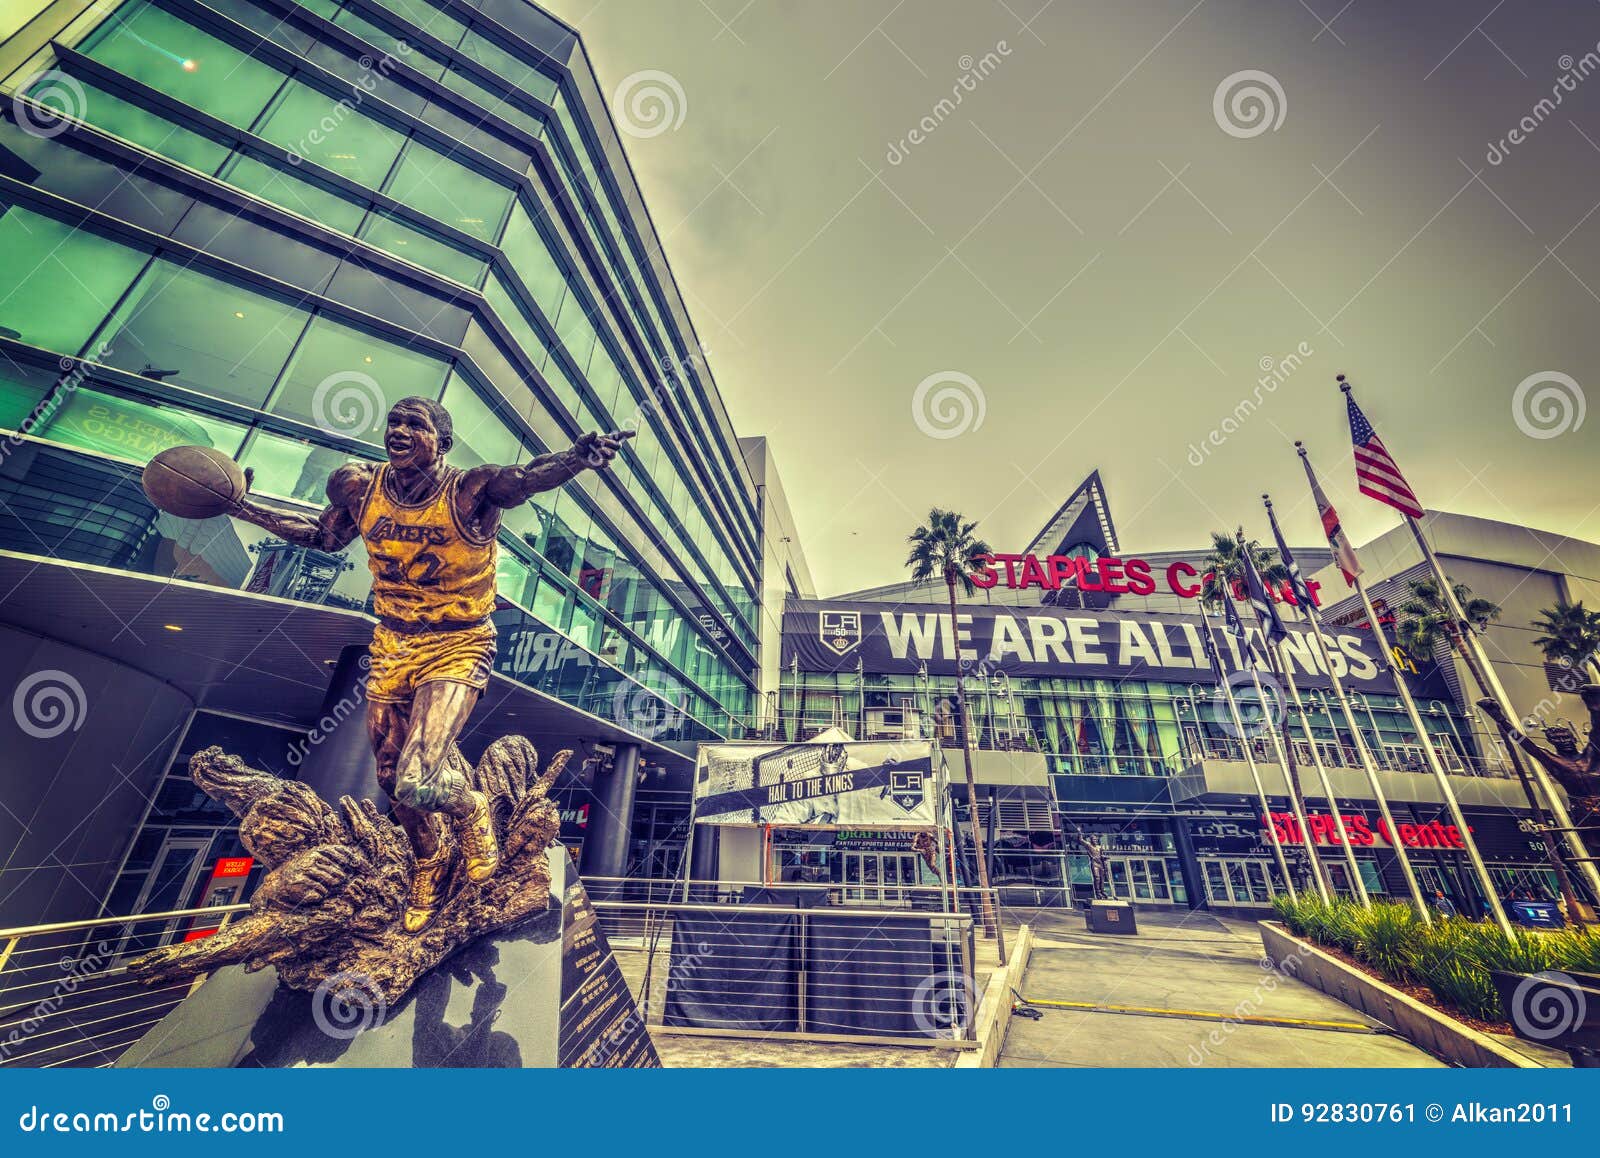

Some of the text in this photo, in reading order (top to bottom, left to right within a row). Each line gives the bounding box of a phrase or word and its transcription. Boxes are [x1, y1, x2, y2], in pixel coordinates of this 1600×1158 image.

[969, 553, 1156, 595] STAPLES
[824, 614, 857, 629] LA
[880, 611, 1378, 680] WE ARE ALL KINGS
[768, 773, 854, 803] HAIL TO THE KINGS
[893, 775, 921, 788] LA
[837, 830, 917, 840] DRAFTKING
[1262, 812, 1375, 845] STPLES
